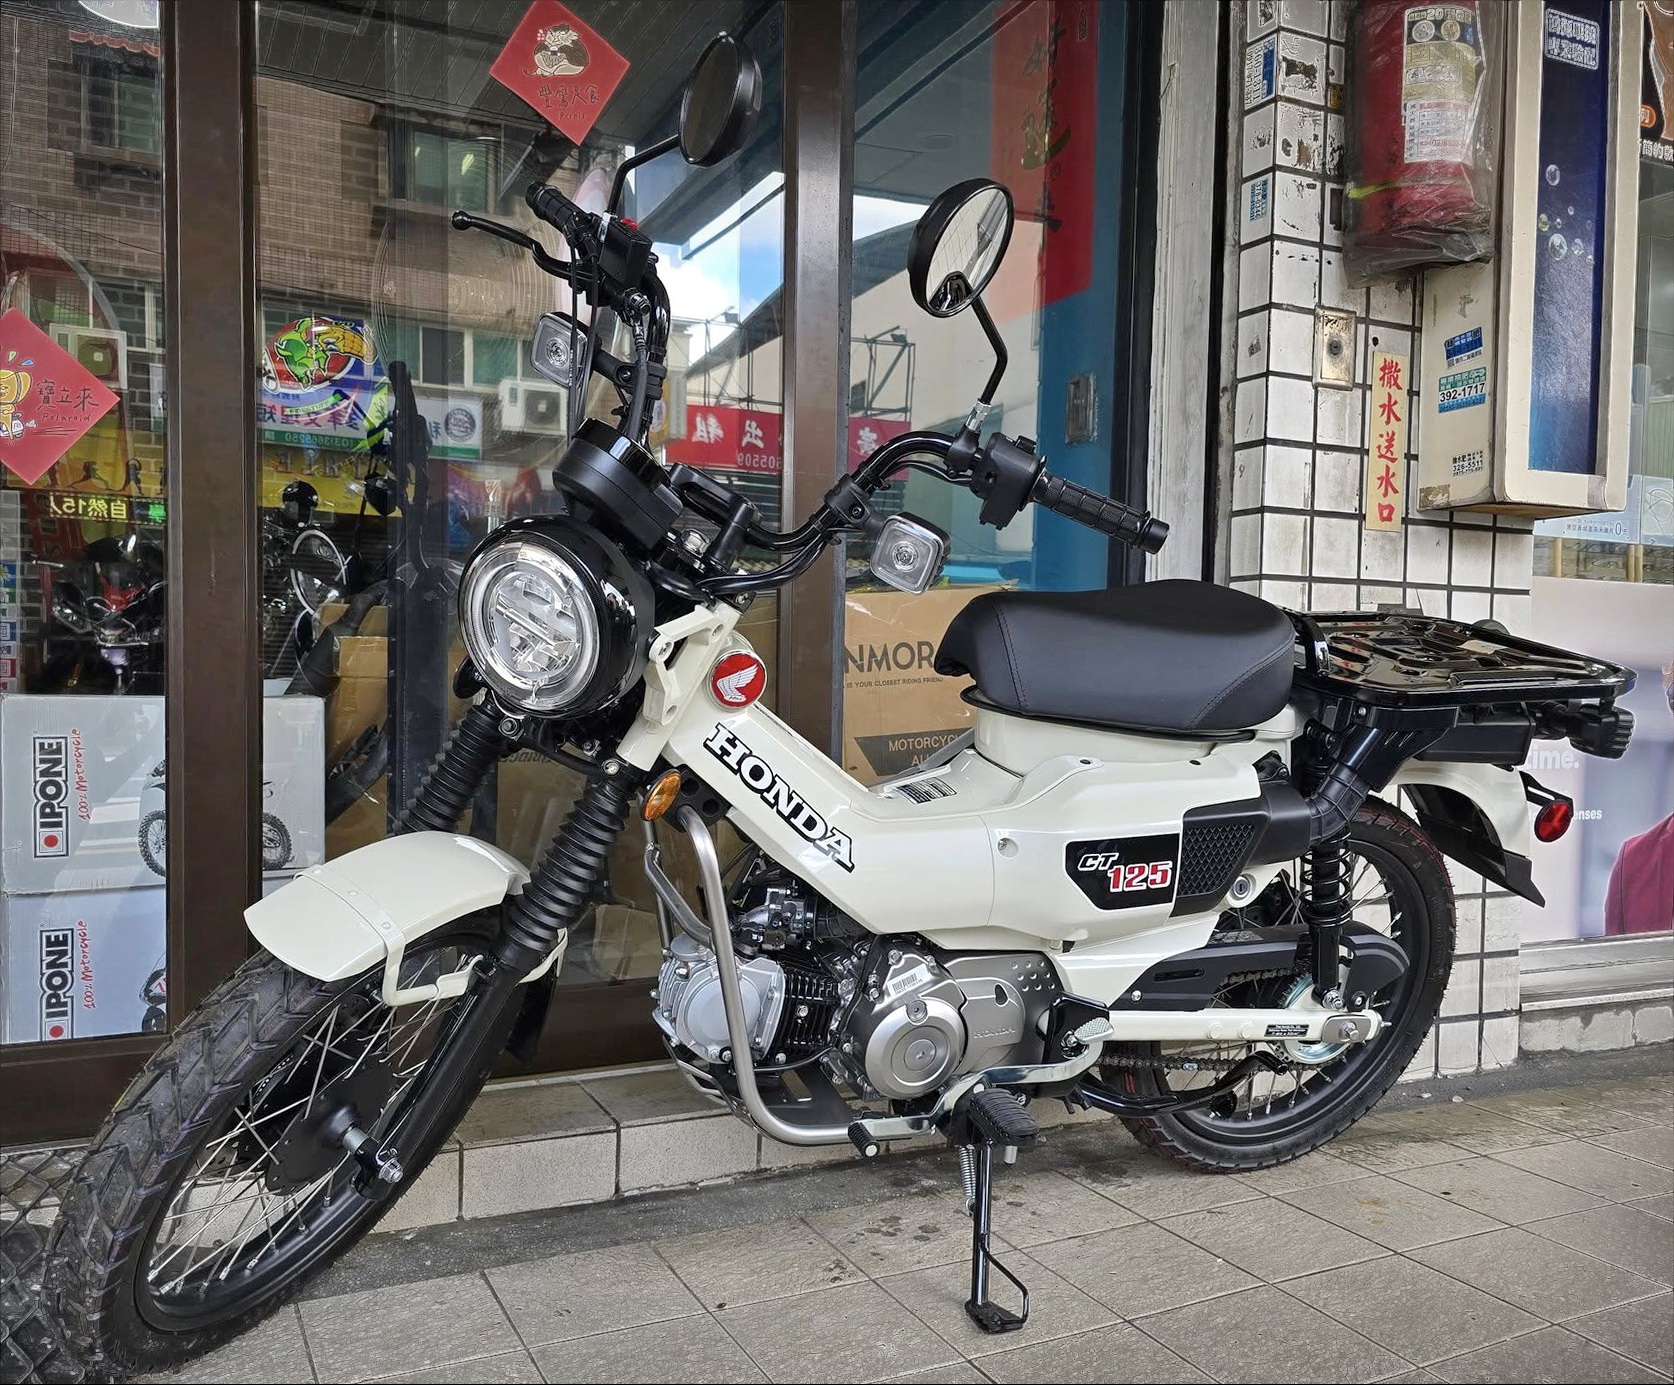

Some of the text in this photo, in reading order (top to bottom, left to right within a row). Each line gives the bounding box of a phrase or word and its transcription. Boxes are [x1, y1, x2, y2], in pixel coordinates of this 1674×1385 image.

[37, 379, 100, 411] 寶立來
[1440, 383, 1485, 402] 392-1717
[42, 412, 92, 422] Polaroid
[1377, 357, 1403, 522] 撒水送水口
[875, 679, 900, 687] CLOSEST
[902, 677, 922, 685] RIDING
[889, 735, 958, 752] MOTORCYC
[70, 728, 89, 792] Motorcycle
[38, 740, 65, 828] IPONE
[703, 722, 855, 873] HONDA
[1077, 853, 1119, 871] CT
[1107, 861, 1173, 892] 125
[75, 919, 93, 982] Motorcycle
[45, 931, 69, 1018] IPONE
